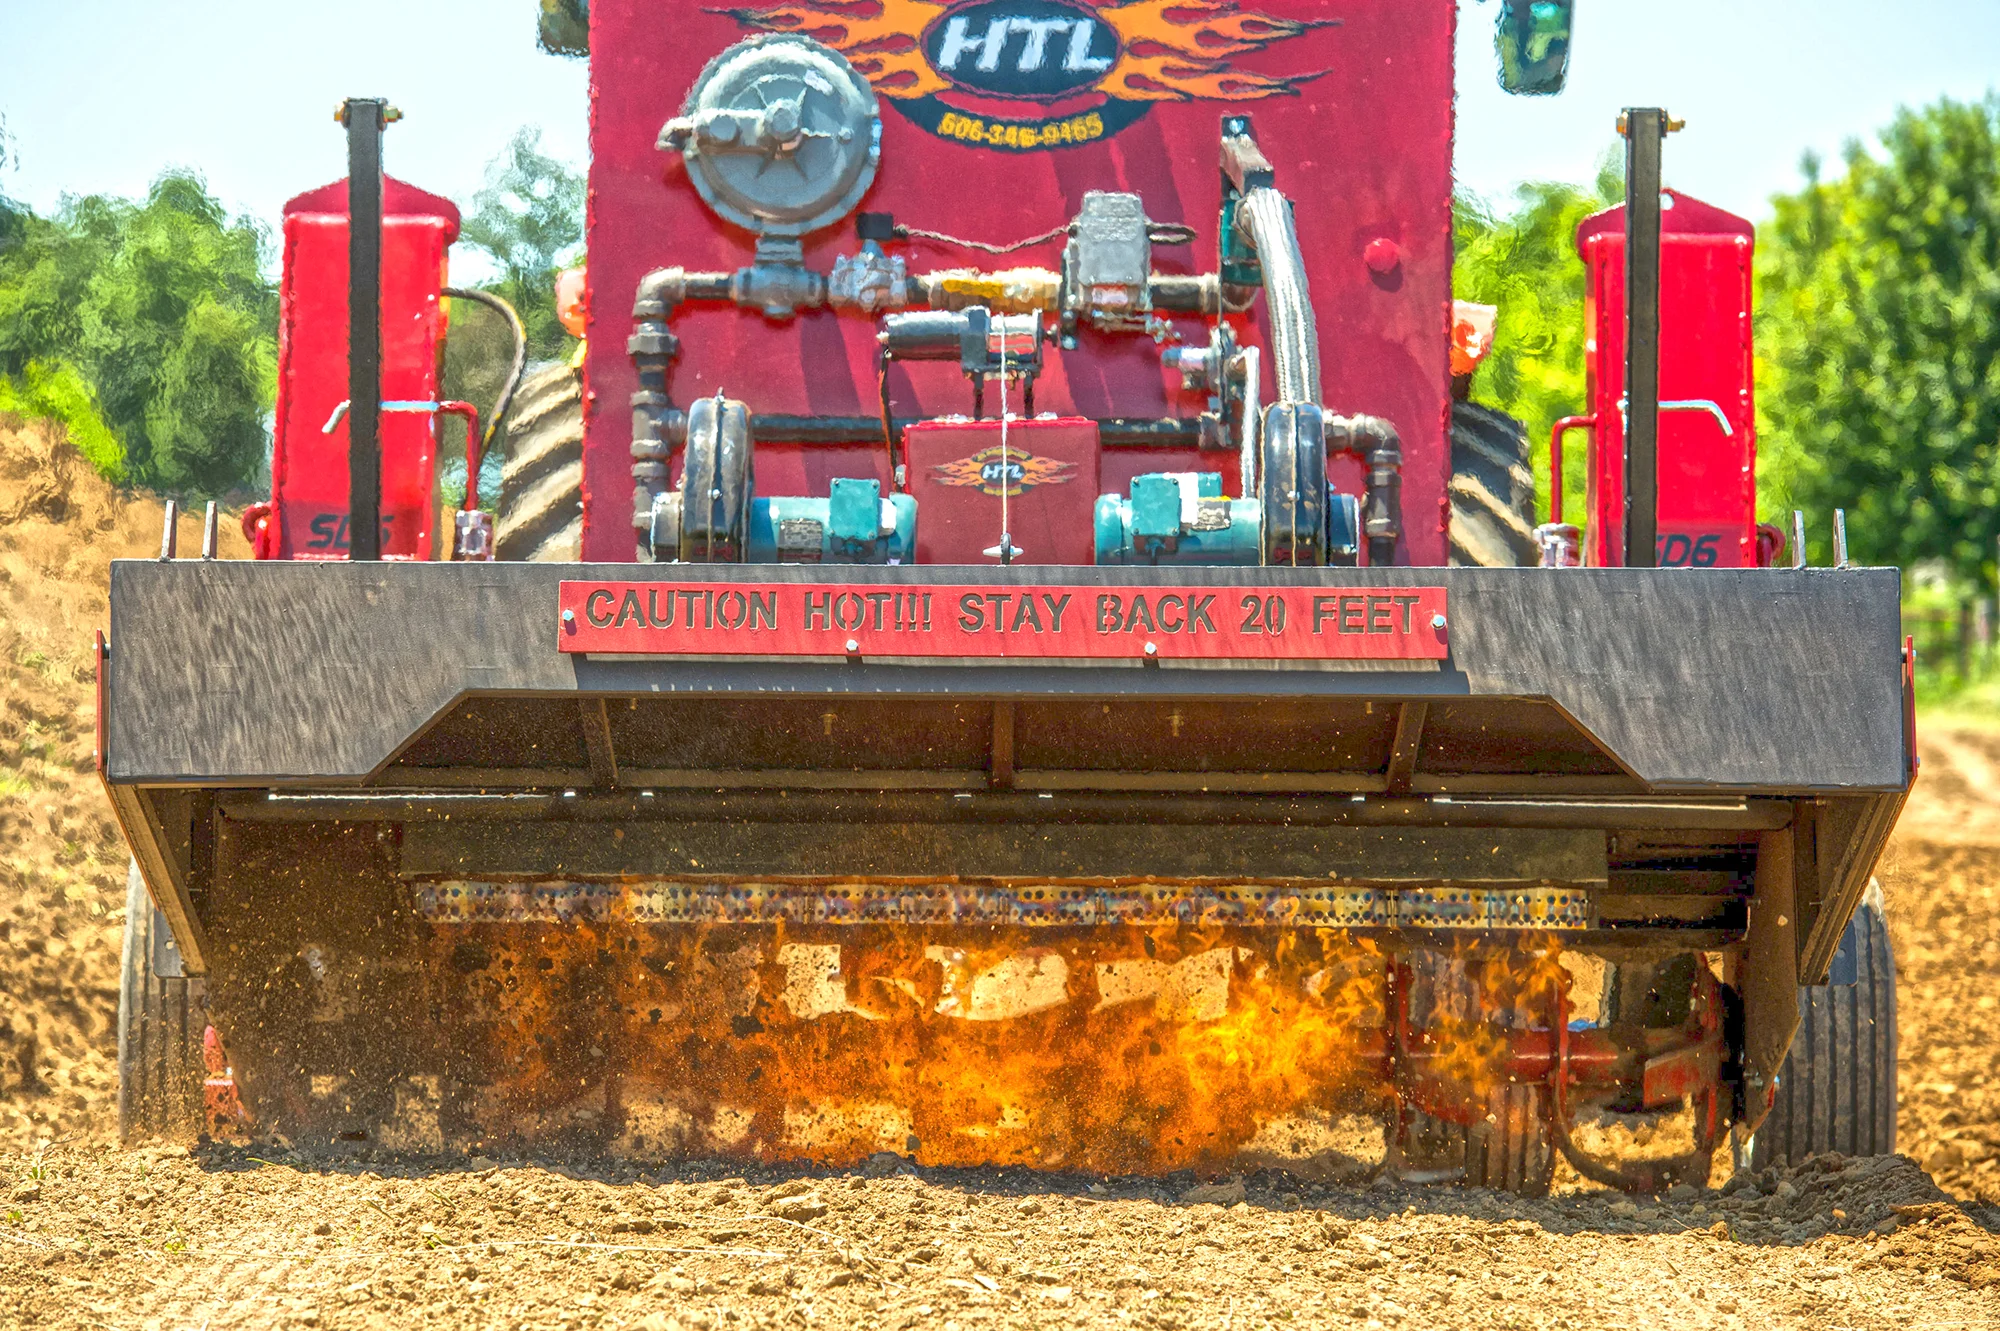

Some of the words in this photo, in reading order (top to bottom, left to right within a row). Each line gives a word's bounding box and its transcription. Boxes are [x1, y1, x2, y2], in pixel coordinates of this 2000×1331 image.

[936, 15, 1114, 72] HTL
[1656, 534, 1721, 567] D6
[586, 589, 777, 630] CAUTION
[804, 591, 932, 632] HOT!!!
[957, 593, 1072, 634] STAY
[1096, 594, 1217, 635] BACK
[1239, 594, 1287, 635] 20
[1312, 595, 1421, 636] FEET
